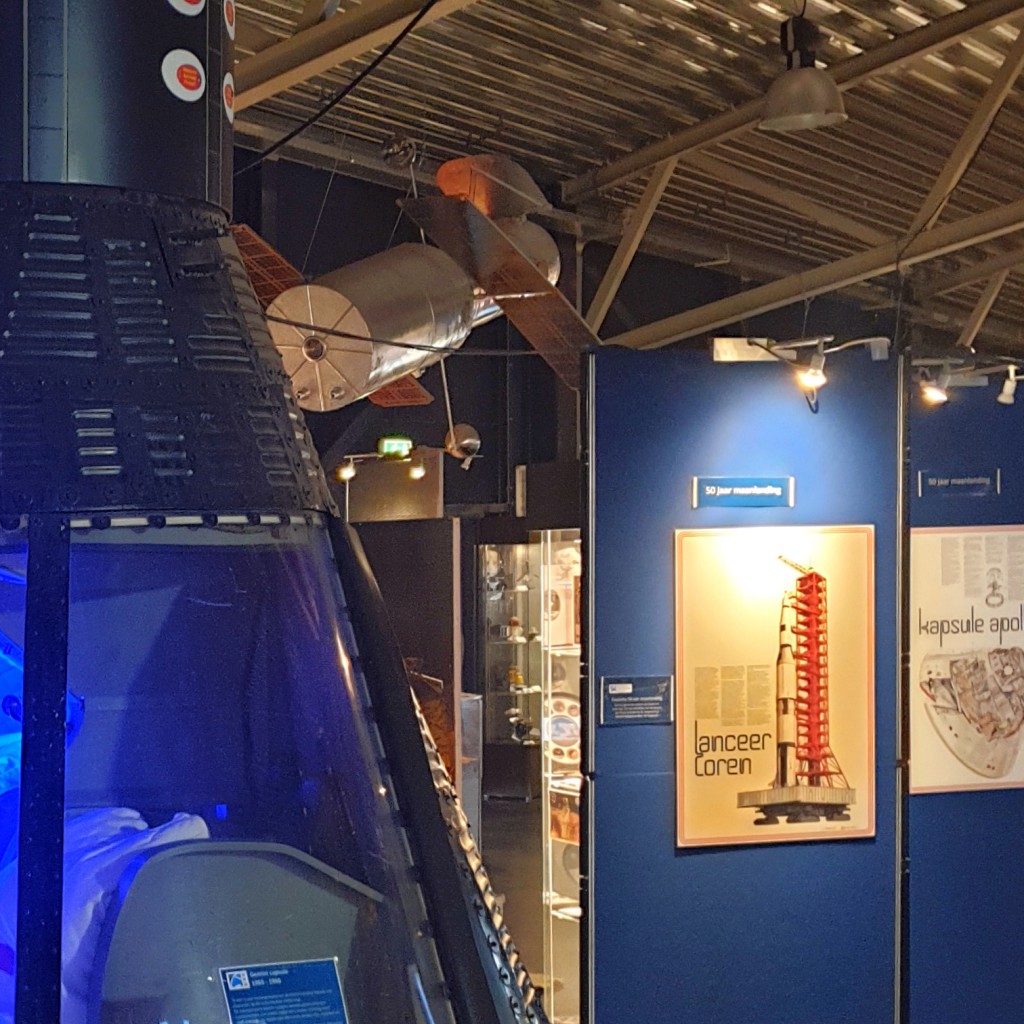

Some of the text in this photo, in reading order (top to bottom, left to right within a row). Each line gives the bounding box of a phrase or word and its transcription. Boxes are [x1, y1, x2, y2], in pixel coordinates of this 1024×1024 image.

[705, 486, 716, 495] 50
[716, 486, 732, 496] jaar
[918, 605, 985, 648] kapsule
